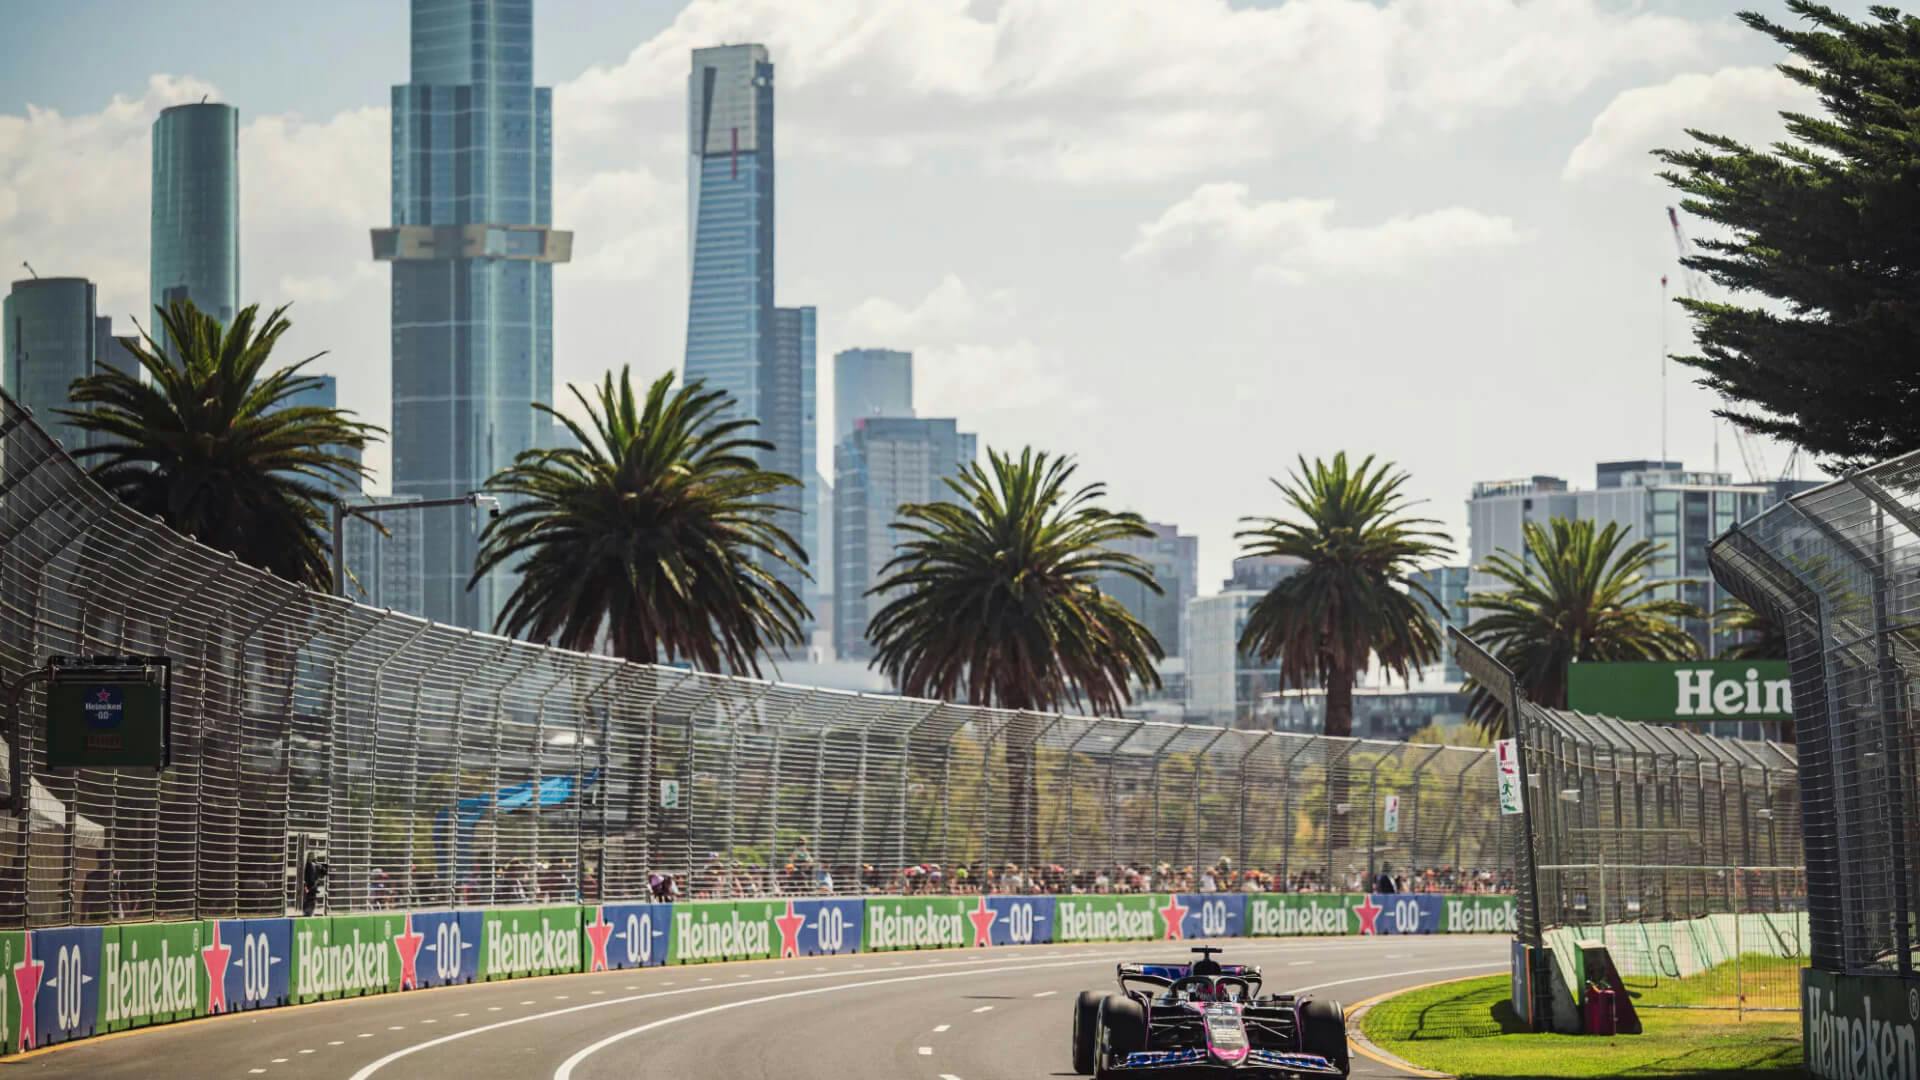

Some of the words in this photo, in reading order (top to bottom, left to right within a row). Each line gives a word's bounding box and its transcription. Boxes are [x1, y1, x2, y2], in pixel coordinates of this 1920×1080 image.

[85, 702, 121, 710] Heineken
[1674, 668, 1792, 715] Hein
[677, 911, 769, 960] Heineken
[869, 905, 963, 948] Heineken
[1060, 902, 1154, 940] Heineken
[1252, 900, 1348, 933] Heineken
[1447, 900, 1518, 931] Heinek
[298, 929, 390, 995] Heineken
[487, 918, 579, 974] Heineken
[106, 940, 197, 1021] Heineken
[244, 933, 269, 1000] 0.0
[1808, 986, 1916, 1080] Heineken
